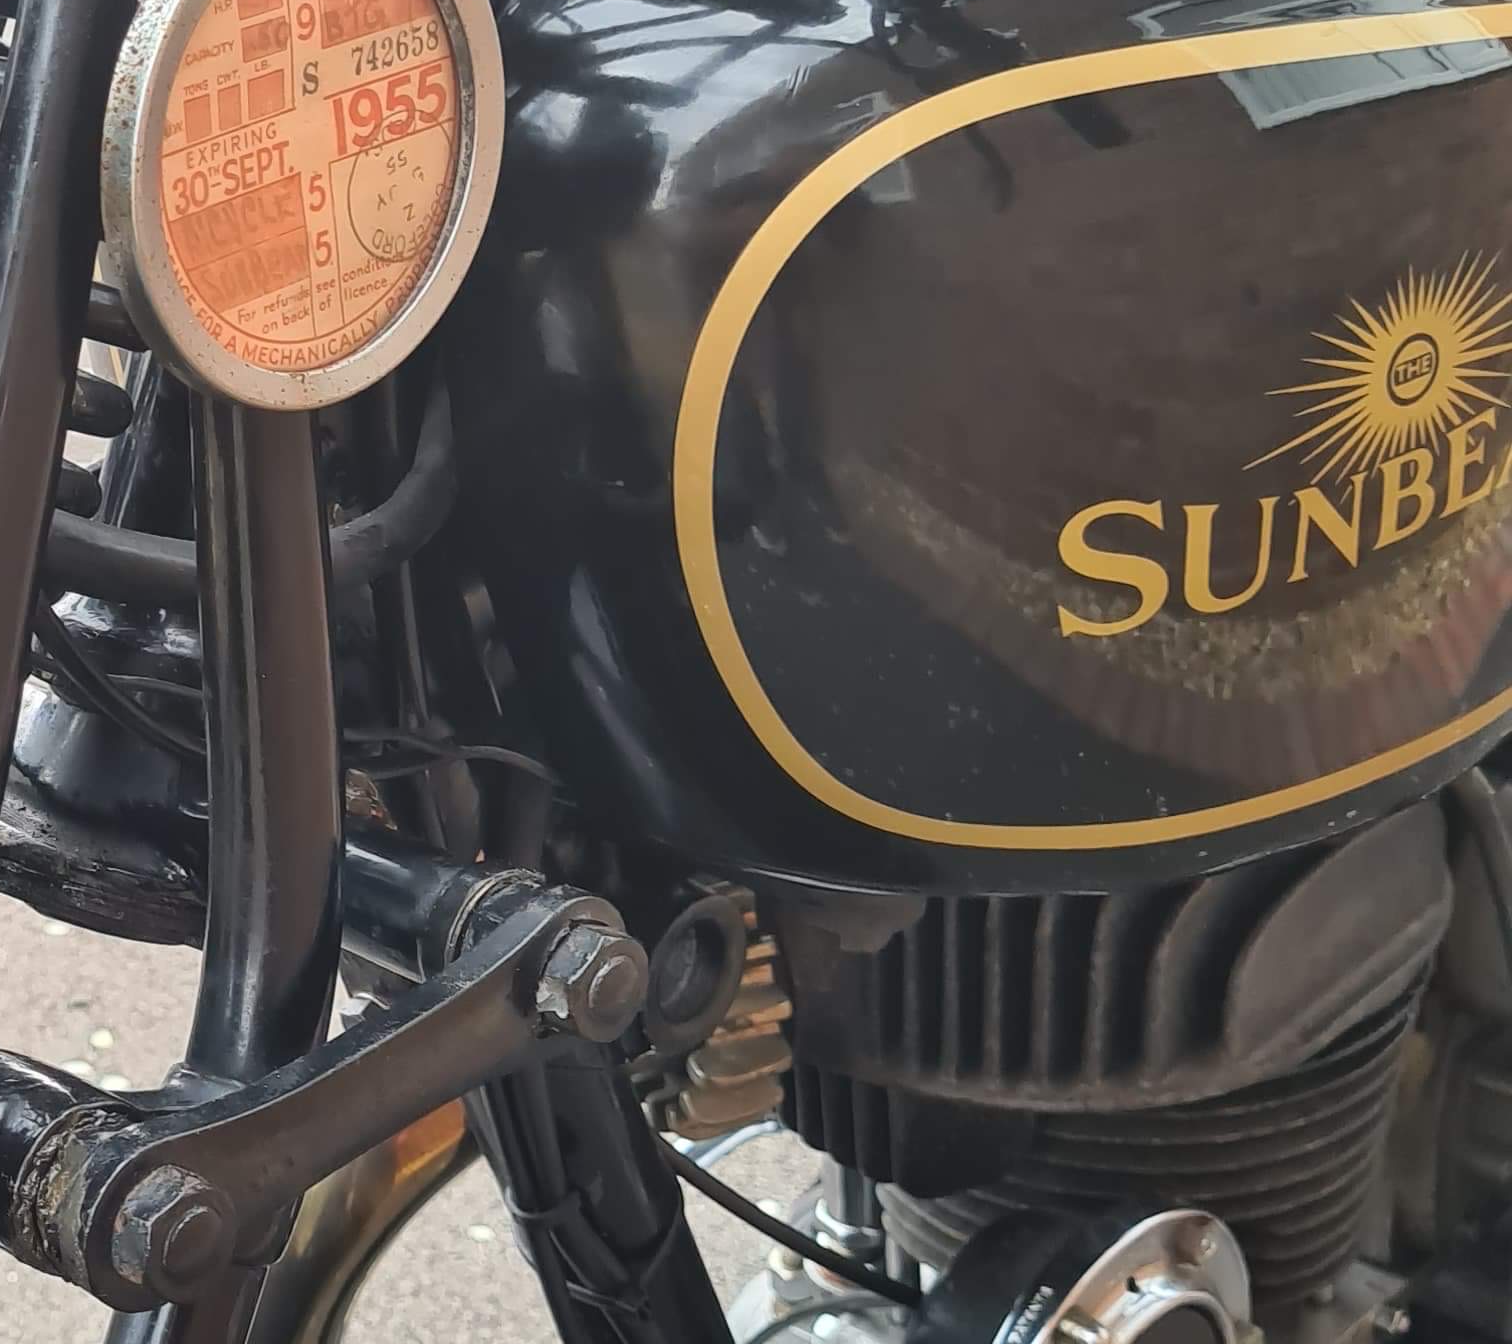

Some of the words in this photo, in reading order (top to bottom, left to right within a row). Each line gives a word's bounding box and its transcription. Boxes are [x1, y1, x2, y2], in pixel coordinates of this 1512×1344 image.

[185, 40, 235, 66] CAPACITY
[302, 60, 319, 97] S
[351, 19, 439, 76] 742658
[332, 62, 447, 156] 1955
[187, 122, 278, 170] EXPIRING
[262, 318, 278, 335] on
[282, 304, 310, 327] back
[319, 293, 332, 312] of
[344, 276, 388, 302] licence
[315, 276, 336, 294] see
[241, 309, 381, 366] MECHANICALLY
[1393, 351, 1433, 387] THE
[1056, 407, 1512, 637] SUNBE
